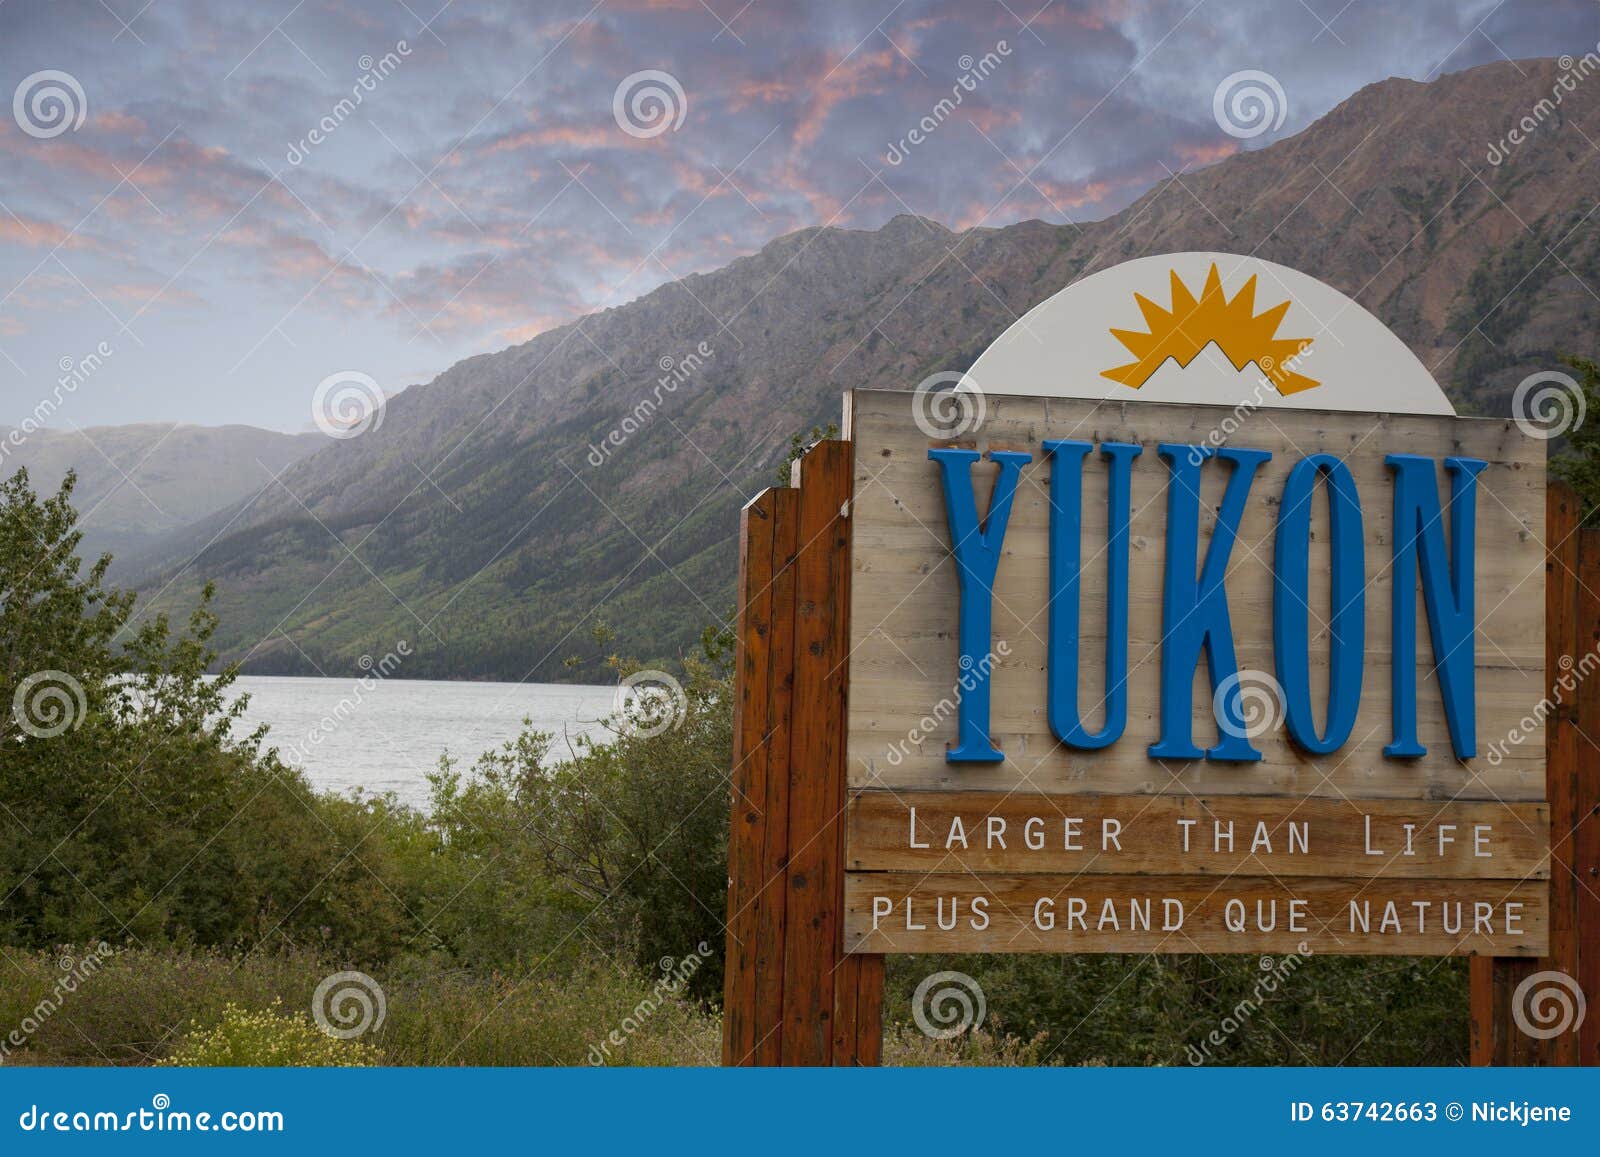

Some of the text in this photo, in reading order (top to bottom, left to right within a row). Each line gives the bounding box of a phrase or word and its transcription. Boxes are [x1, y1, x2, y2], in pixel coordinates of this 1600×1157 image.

[928, 440, 1488, 764] YUKON
[908, 807, 1493, 858] LARGER THAN LIFE
[872, 896, 1525, 935] PLUS GRAND QUE NATURE
